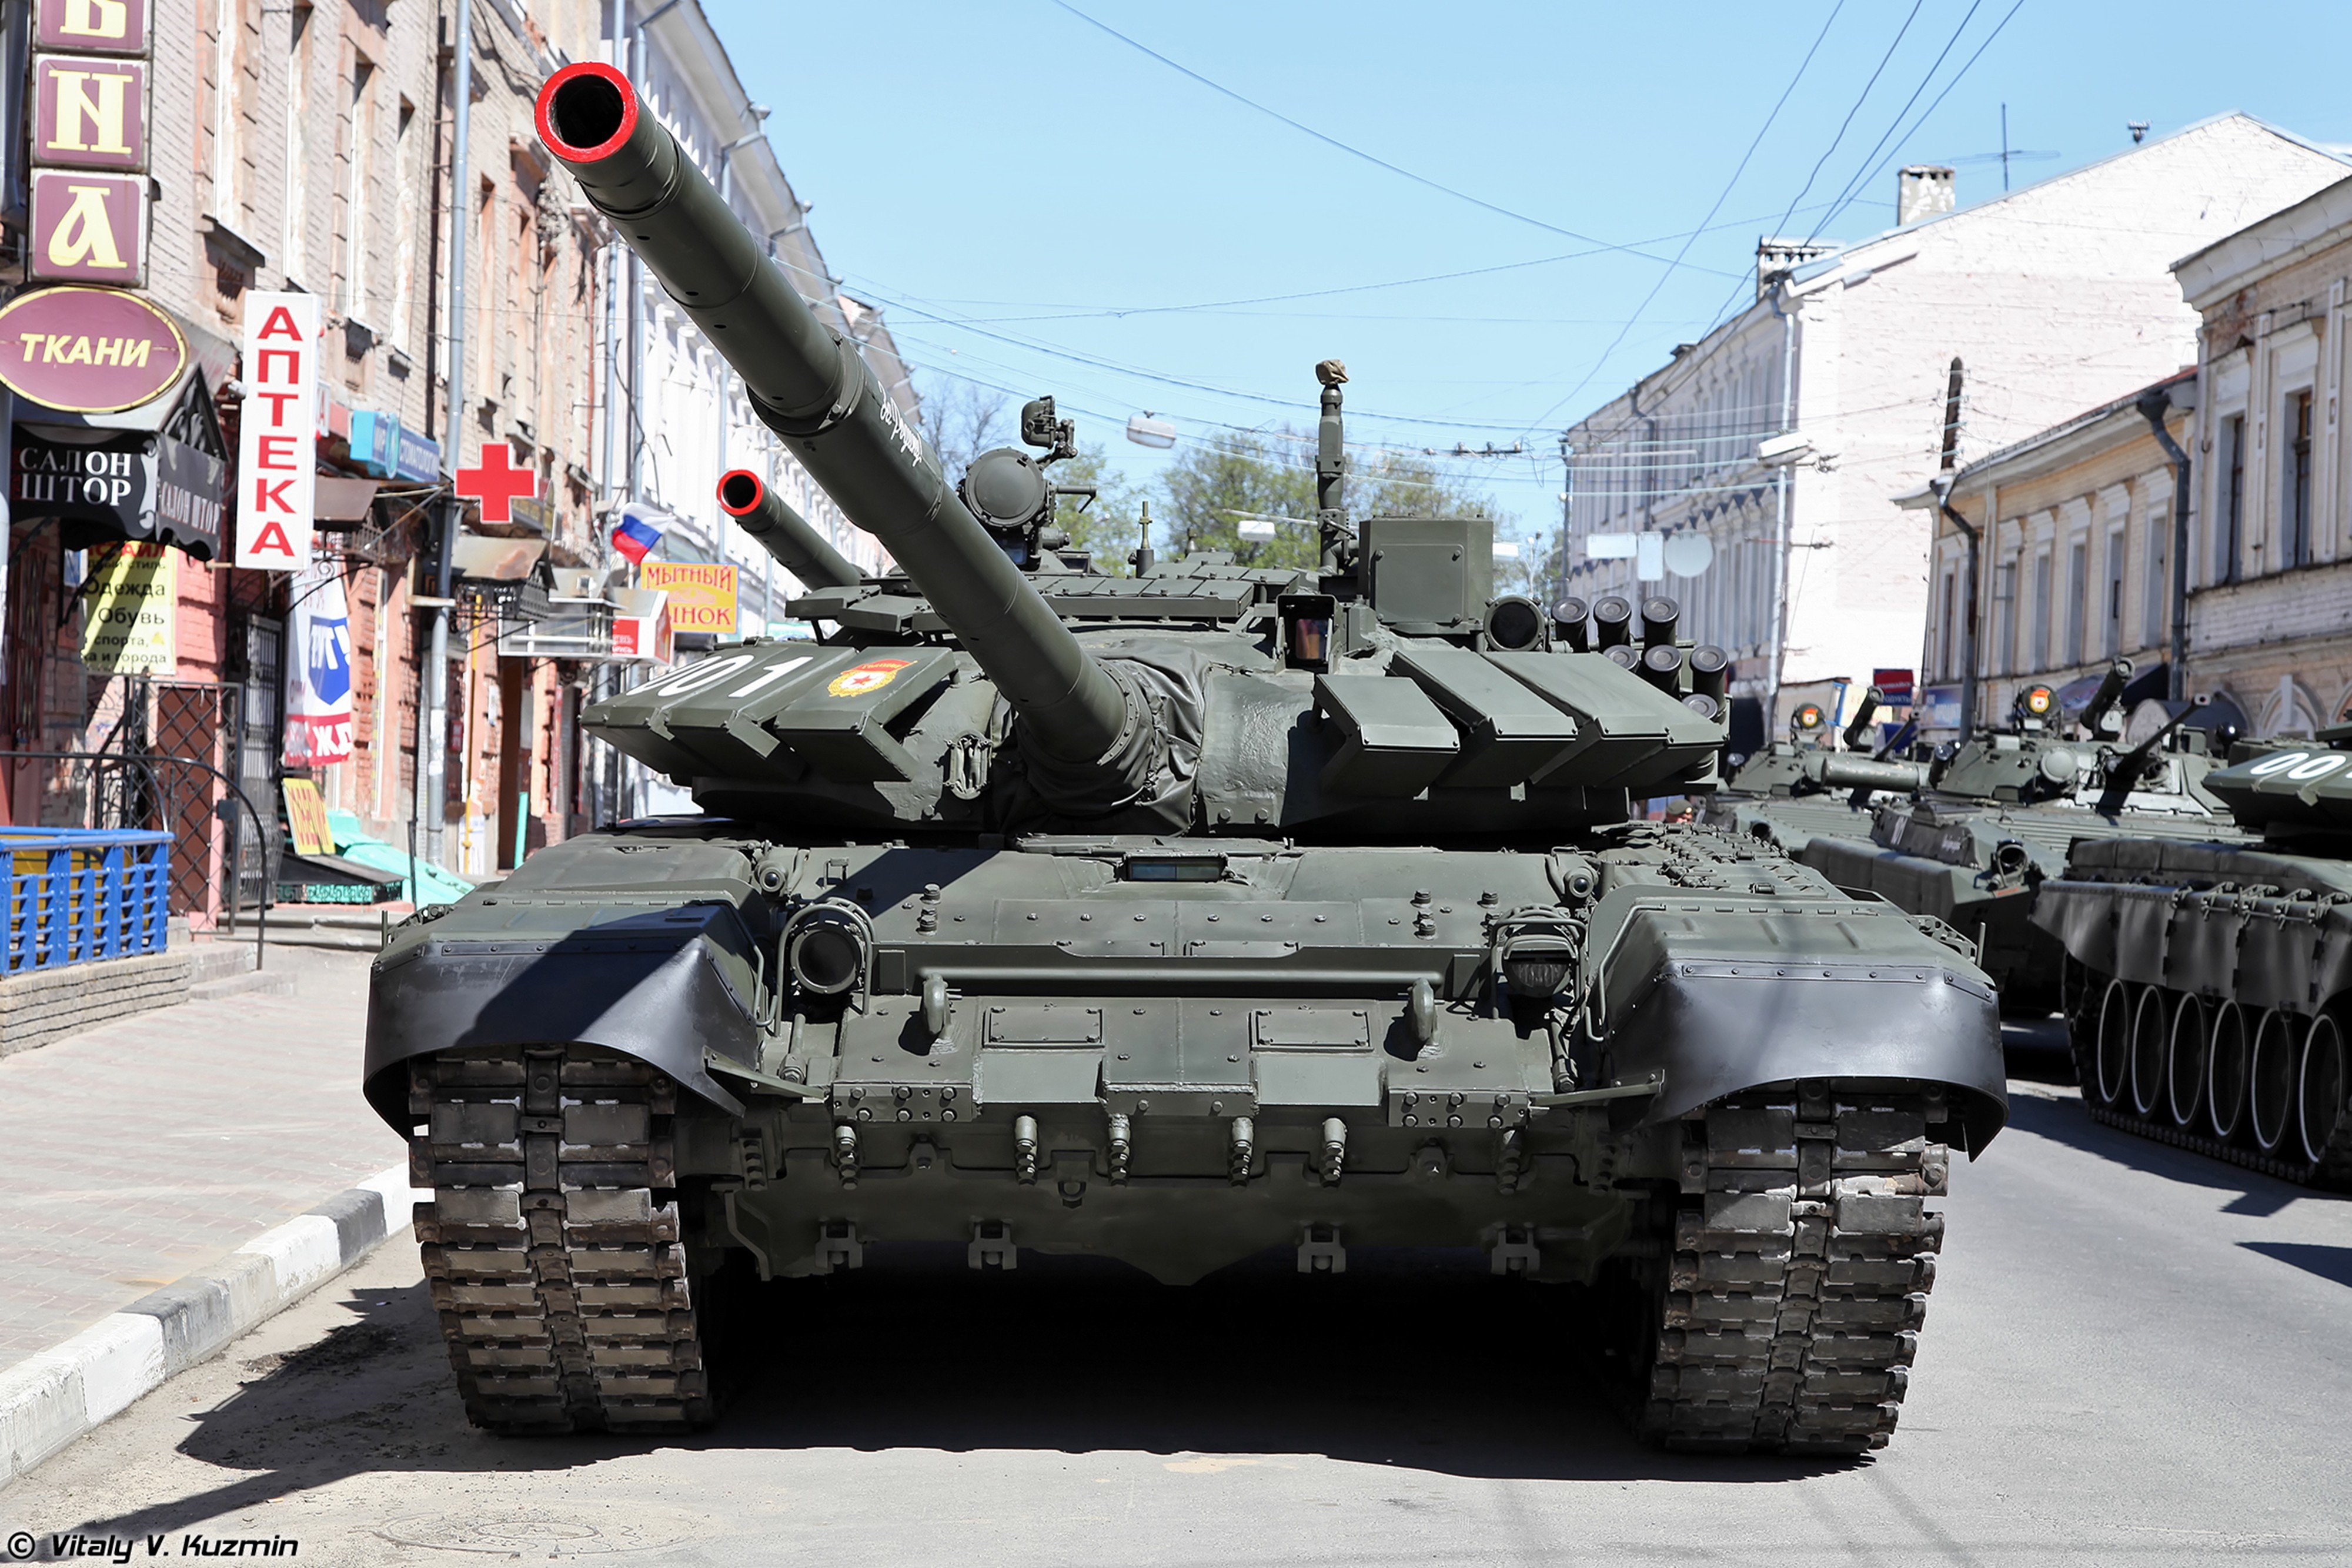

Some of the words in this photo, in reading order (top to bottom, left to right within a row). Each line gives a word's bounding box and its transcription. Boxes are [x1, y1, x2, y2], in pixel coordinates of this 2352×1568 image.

[20, 333, 151, 367] ТКАНИ
[249, 306, 303, 557] АПТЕКА
[19, 447, 132, 477] САЛОН
[21, 473, 131, 506] ШТОР
[161, 481, 191, 524] САЛОН
[192, 494, 219, 535] ШТОР
[86, 576, 165, 598] Одежда
[647, 566, 731, 592] МЫТНЫЙ
[99, 607, 165, 627] Обувь
[673, 606, 731, 625] НОК
[626, 654, 814, 698] 001
[2250, 753, 2352, 780] 00
